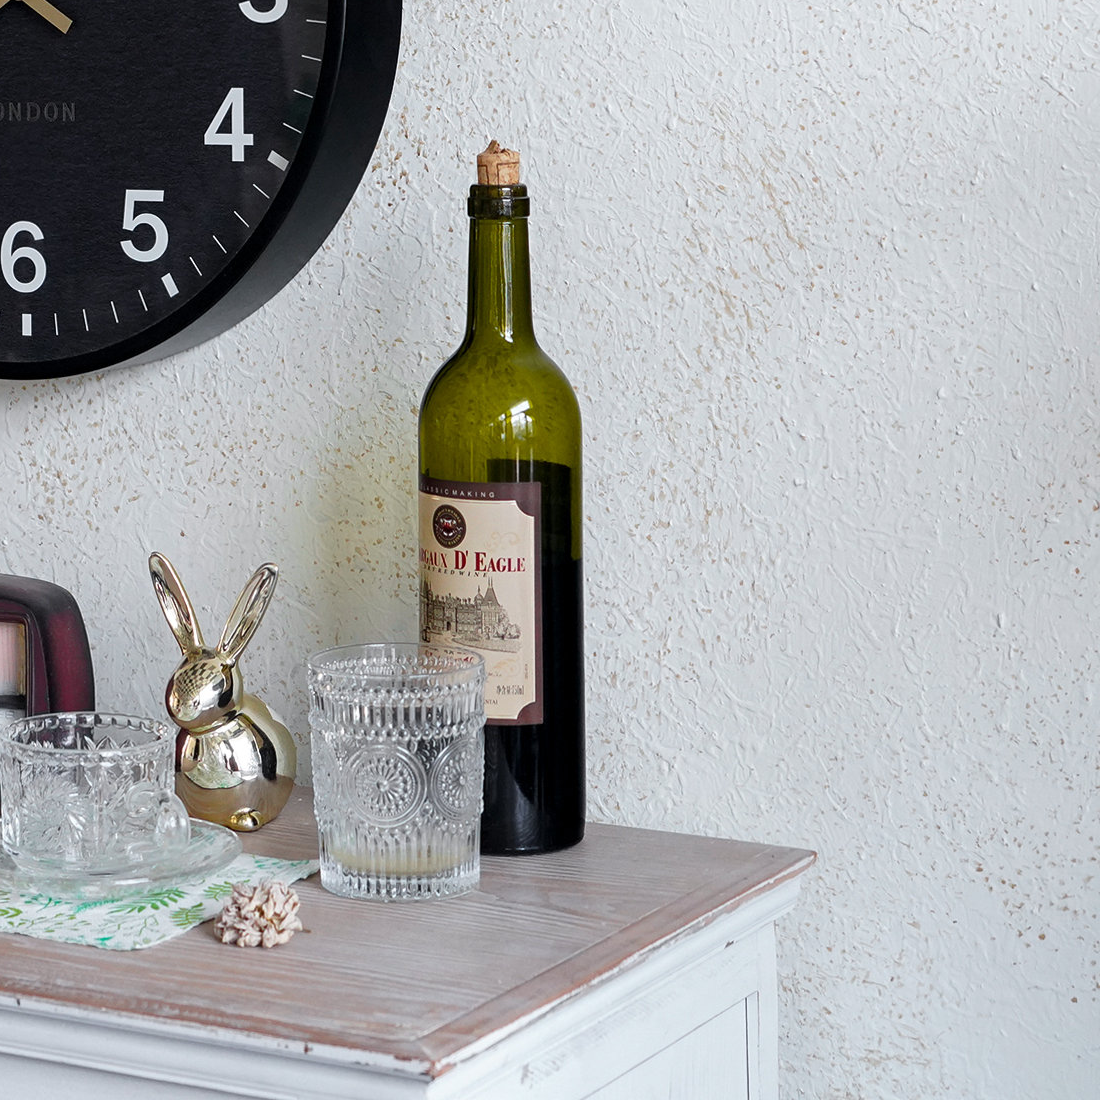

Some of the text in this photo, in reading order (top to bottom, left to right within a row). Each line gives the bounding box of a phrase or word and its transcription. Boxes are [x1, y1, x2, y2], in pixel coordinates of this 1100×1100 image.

[204, 88, 253, 161] 4
[1, 221, 46, 292] 6
[120, 190, 168, 262] 5
